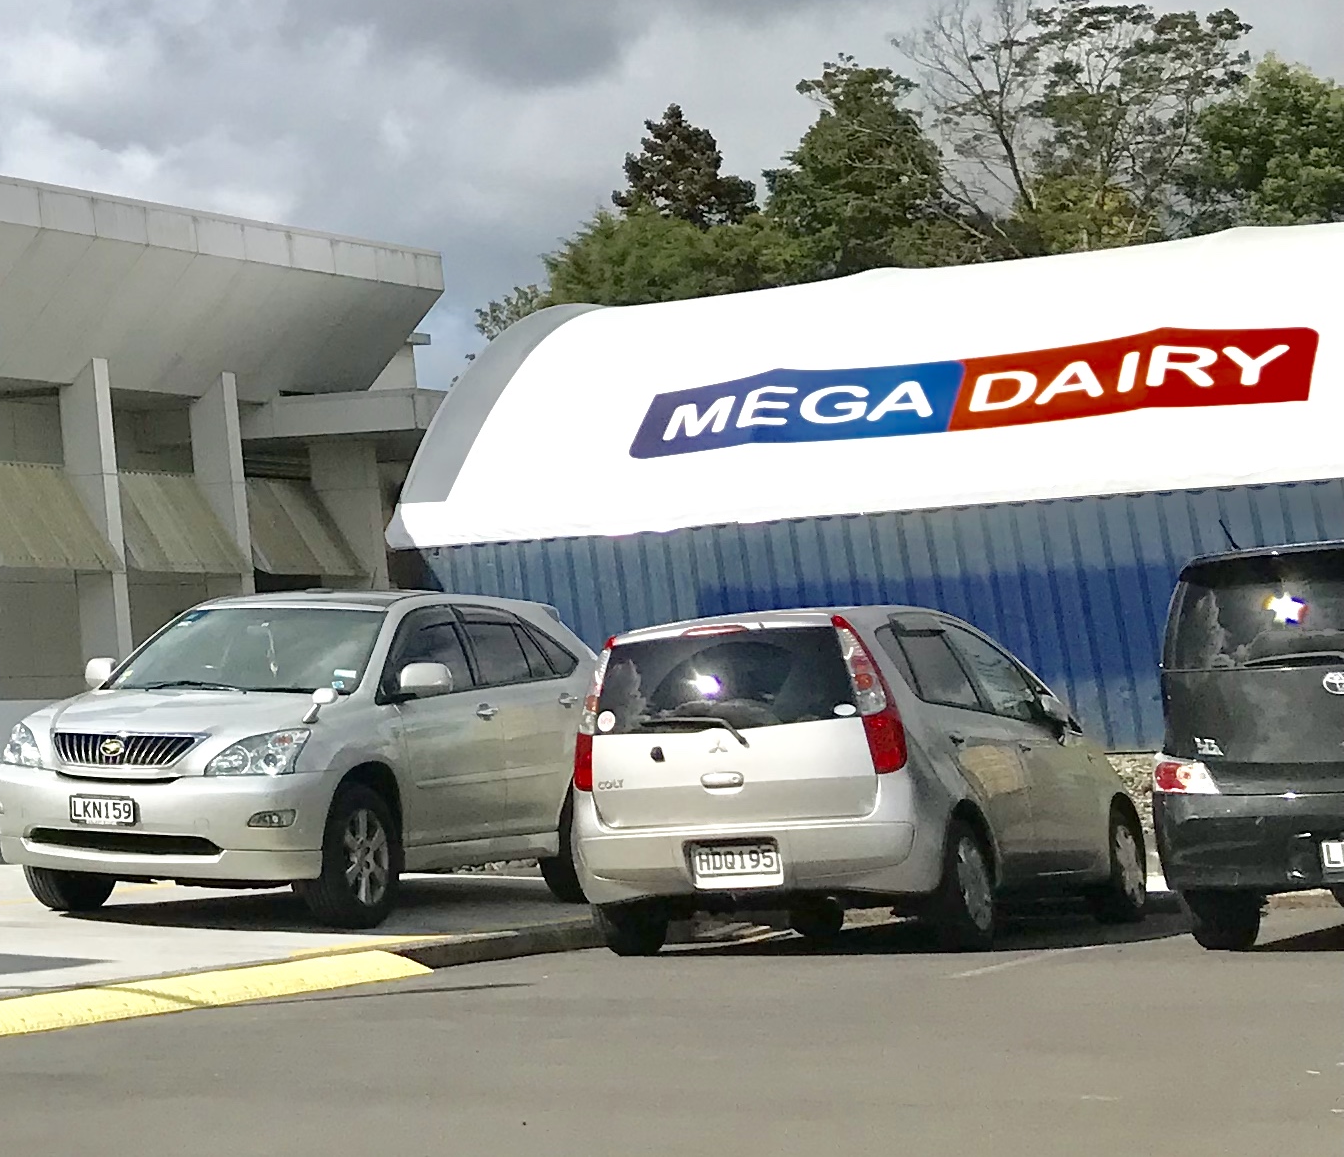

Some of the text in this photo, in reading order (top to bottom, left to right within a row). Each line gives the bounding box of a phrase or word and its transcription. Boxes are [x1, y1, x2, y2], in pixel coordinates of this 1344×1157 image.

[662, 344, 1290, 441] MEGA DAIRY
[73, 800, 132, 820] LKN159
[698, 849, 774, 871] HDQ195
